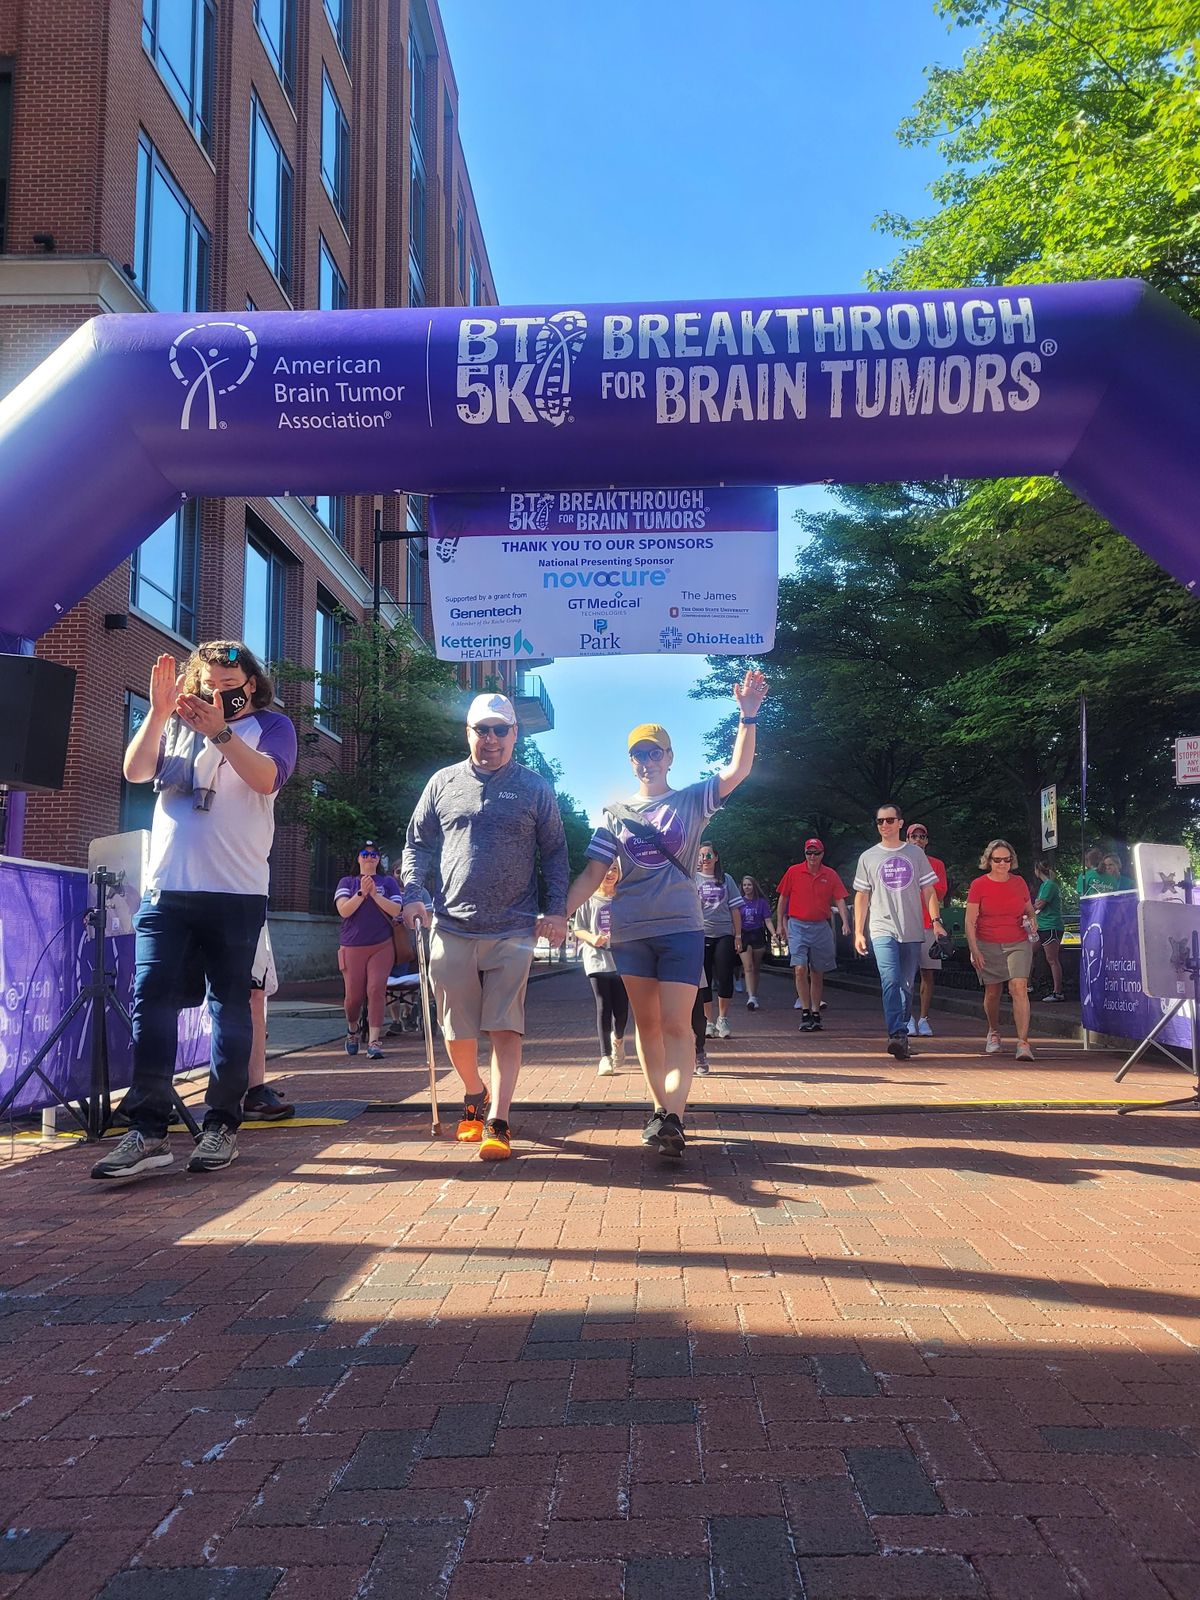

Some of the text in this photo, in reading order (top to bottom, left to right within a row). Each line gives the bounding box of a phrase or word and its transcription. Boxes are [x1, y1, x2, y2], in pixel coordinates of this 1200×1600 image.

[603, 298, 1036, 359] BREAKTHROUGH
[457, 317, 545, 364] BT
[273, 356, 380, 374] American
[274, 382, 405, 402] Brain Tumor
[456, 364, 539, 424] 5K
[601, 371, 646, 399] FOR
[656, 362, 807, 424] BRAIN
[510, 493, 540, 512] BT
[559, 490, 704, 511] BREAKTHROUGH
[508, 512, 537, 531] 5K
[558, 514, 574, 523] FOR
[576, 511, 628, 531] BRAIN
[502, 538, 714, 552] THANK YOU TO OUR SPONSORS
[539, 557, 674, 567] National Presenting Sponsor
[445, 595, 477, 603] Supported
[493, 593, 511, 601] grant
[588, 593, 640, 609] Medical
[681, 591, 737, 601] The James
[450, 605, 522, 619] Genentech
[441, 634, 511, 649] Kettering
[579, 632, 621, 650] Park
[686, 632, 765, 645] OhioHealth
[461, 649, 501, 658] HEALTH
[1187, 741, 1199, 750] NO
[1105, 957, 1136, 971] American
[1105, 977, 1141, 992] Brain Tumo
